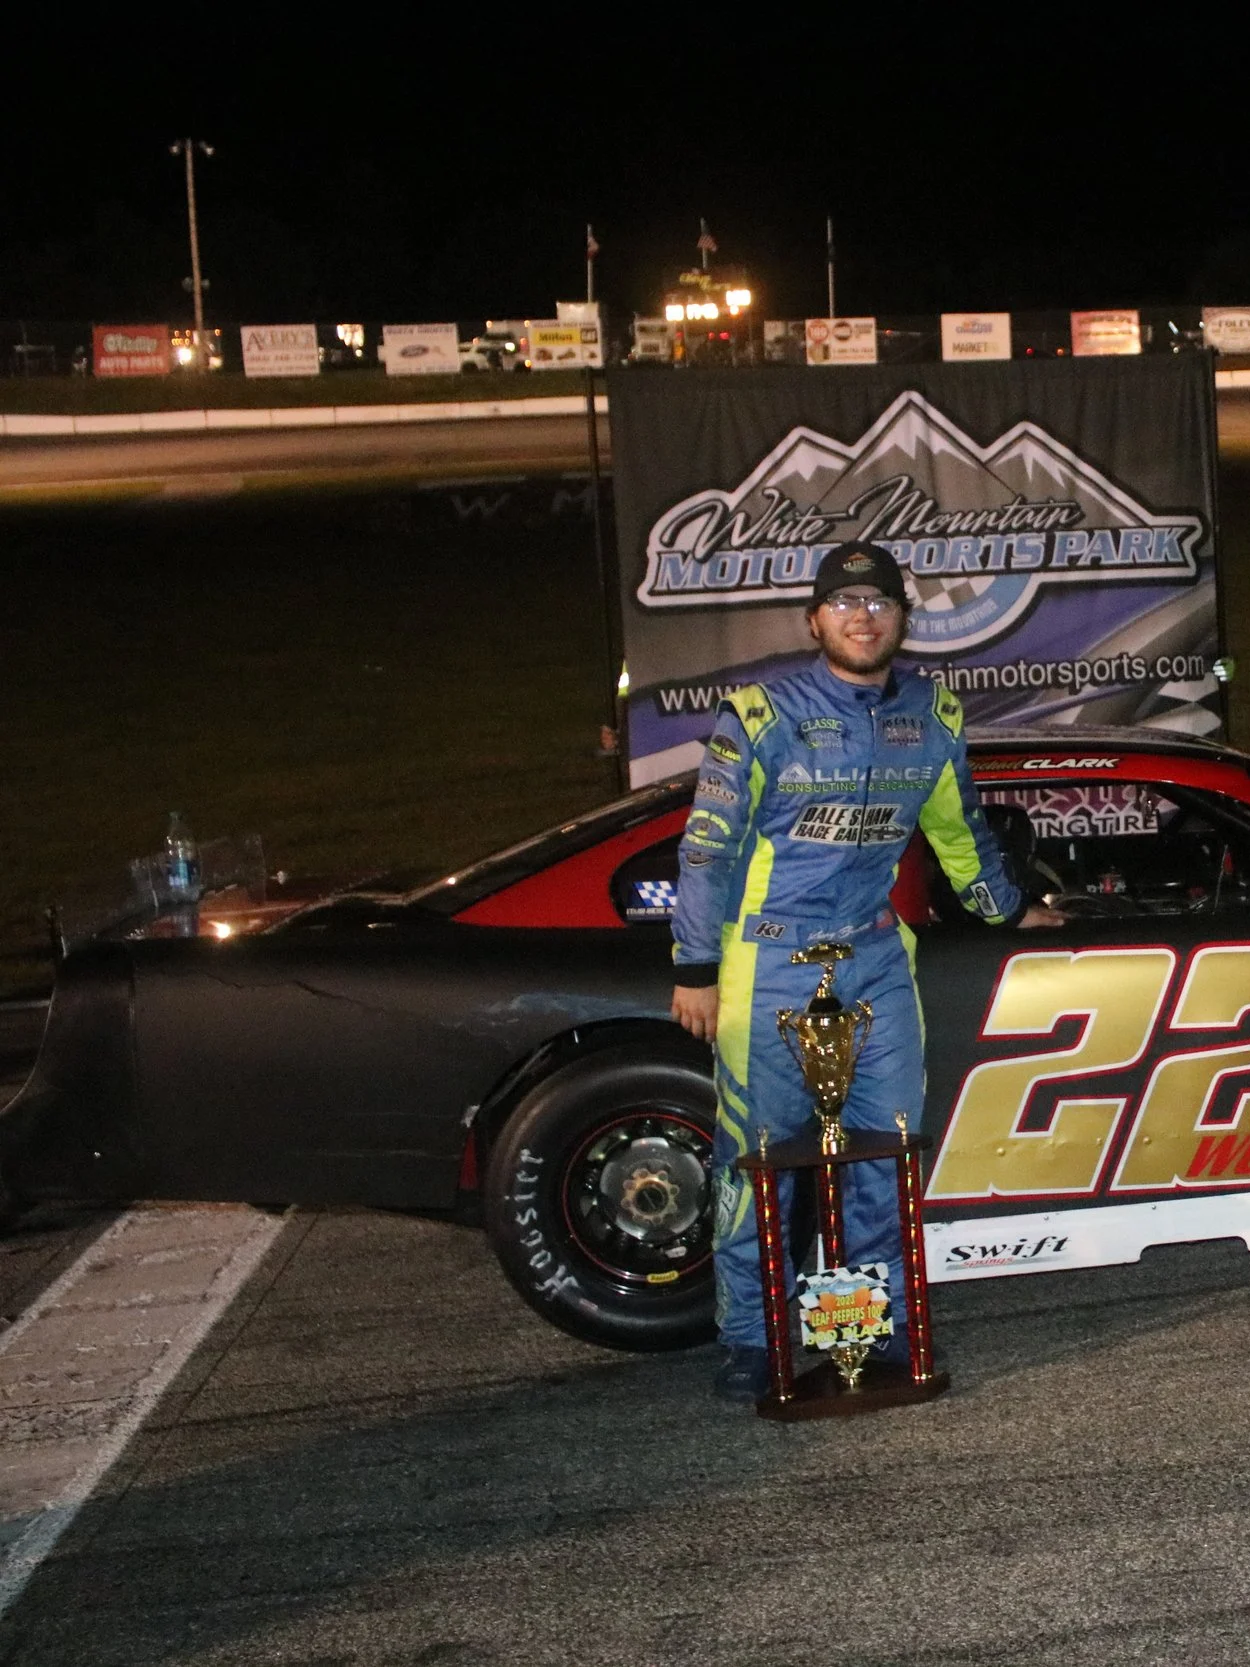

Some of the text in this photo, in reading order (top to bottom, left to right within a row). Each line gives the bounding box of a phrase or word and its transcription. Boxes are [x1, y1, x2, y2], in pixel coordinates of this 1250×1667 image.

[660, 475, 1084, 563] White Mountain
[1049, 526, 1187, 568] PARK
[801, 718, 842, 733] CLASSIC
[1023, 758, 1120, 769] CLARK
[777, 783, 857, 793] CONSULTING
[803, 806, 849, 826] DALE
[1096, 813, 1158, 835] TIRE
[794, 824, 833, 840] RACE
[754, 921, 786, 940] K1
[504, 1149, 580, 1299] Hoosier
[836, 1295, 856, 1307] 2023
[811, 1304, 882, 1327] LEAF PEEPERS 100
[806, 1322, 891, 1345] 3RD PLACE
